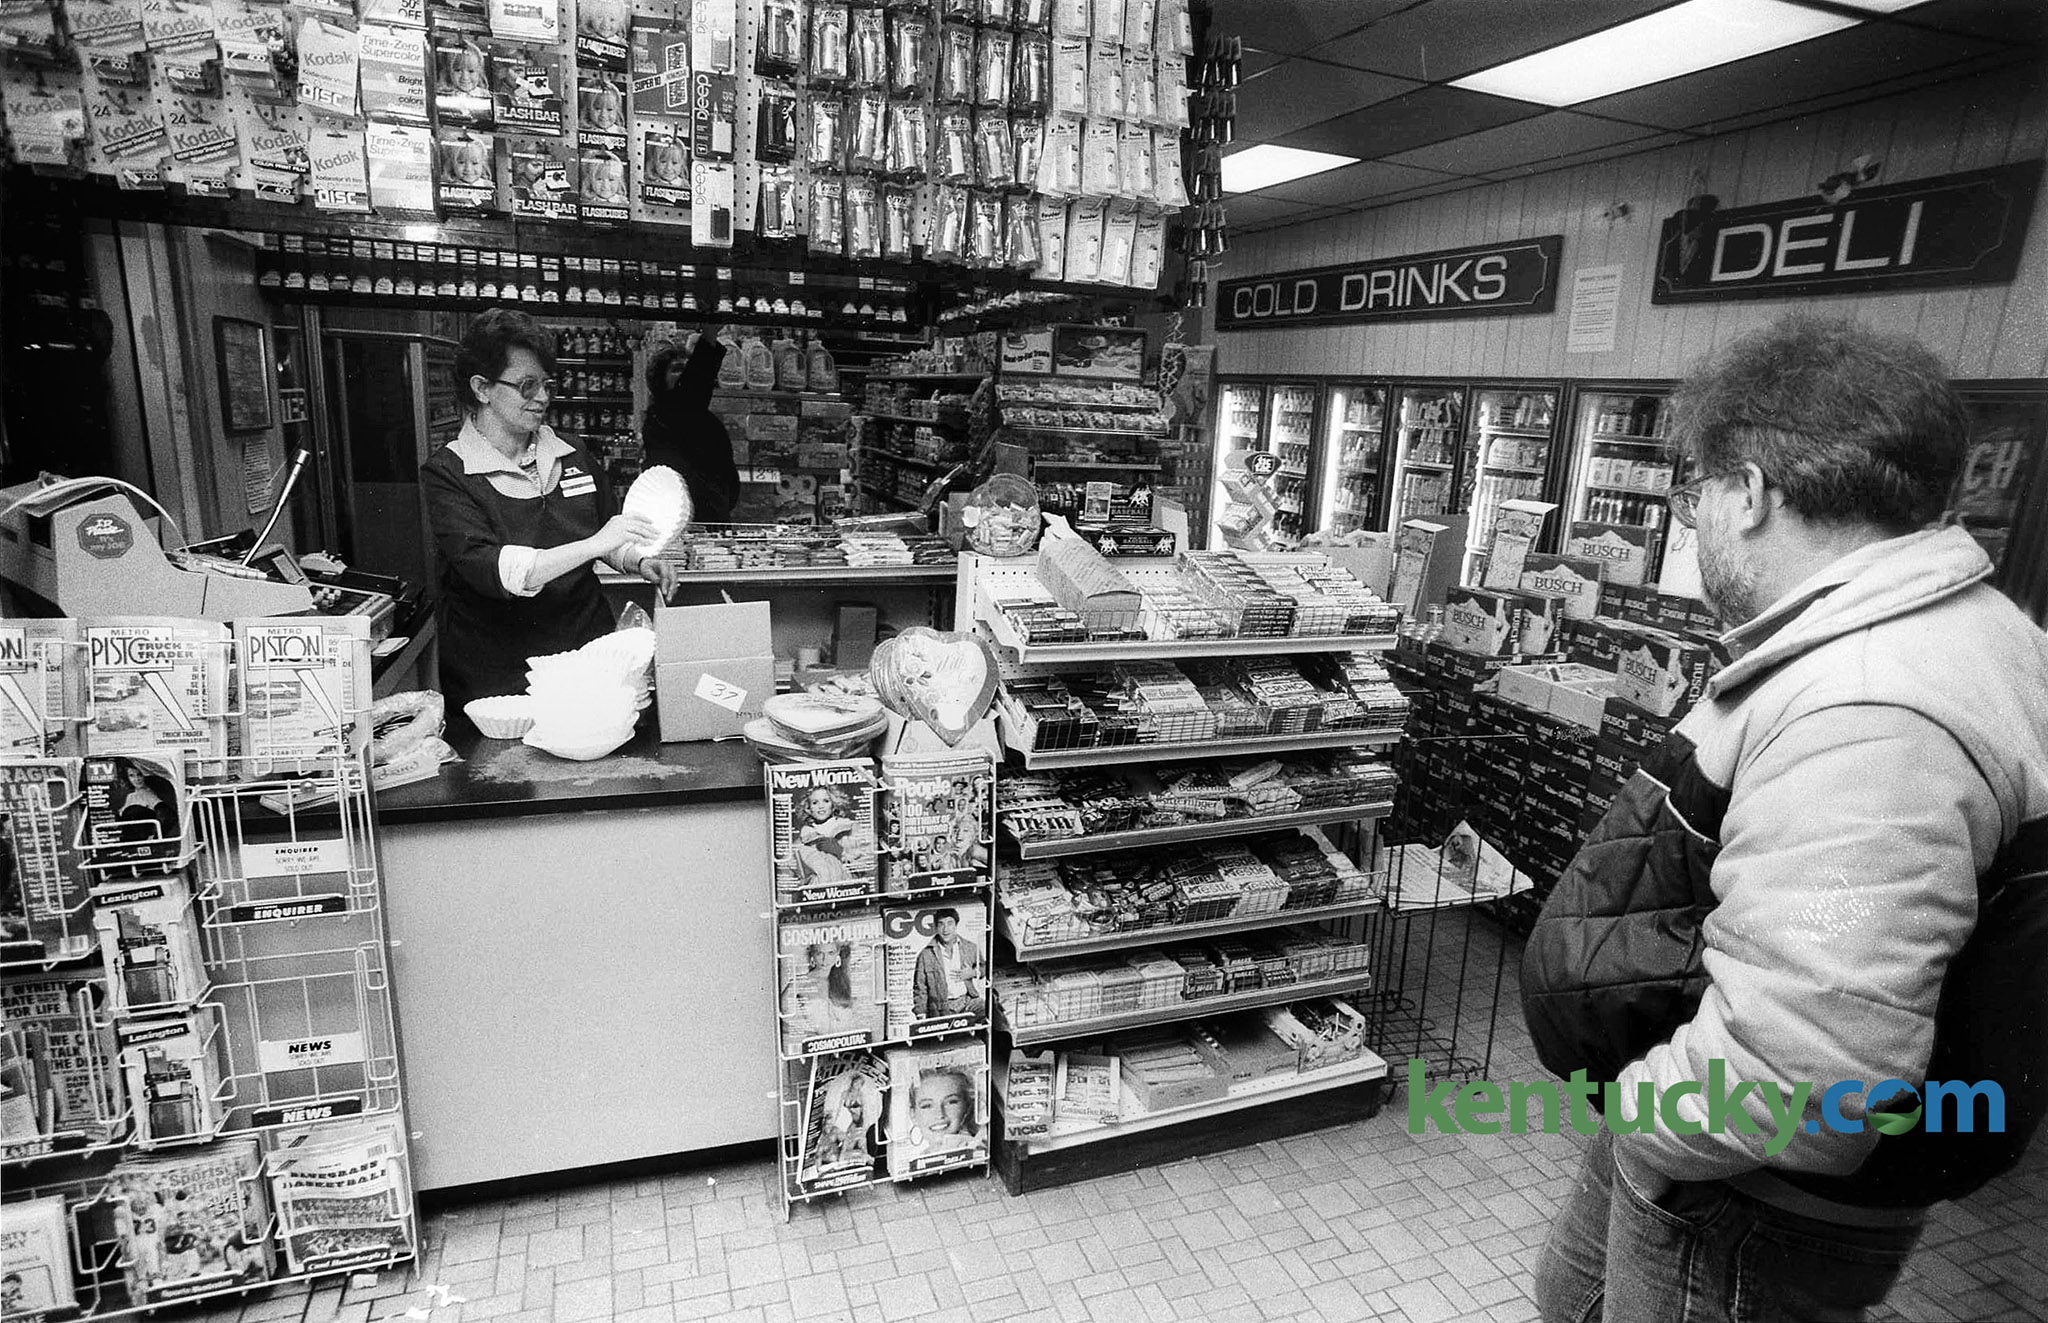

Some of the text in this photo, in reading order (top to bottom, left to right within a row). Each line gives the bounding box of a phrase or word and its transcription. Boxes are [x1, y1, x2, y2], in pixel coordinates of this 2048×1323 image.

[75, 6, 134, 29] Kodak
[218, 12, 277, 30] Kodak
[399, 8, 421, 20] OFF
[149, 14, 209, 37] Kodak
[362, 35, 419, 51] Time-Zero
[578, 37, 626, 58] FLACUBES
[304, 51, 353, 66] Kodak
[362, 45, 421, 61] Supercolor
[399, 76, 423, 86] Bright
[634, 78, 654, 91] SUPER
[407, 87, 423, 95] rich
[9, 100, 65, 118] Koda
[92, 105, 111, 117] 24
[496, 107, 560, 122] FLASH BAR
[169, 113, 187, 125] 24
[100, 115, 158, 143] Kodak
[174, 124, 232, 149] Kodak
[251, 130, 304, 151] Kodak
[314, 151, 360, 171] Kodak
[515, 199, 577, 213] FLASH BAR
[582, 206, 628, 219] FLASHCUBES
[1710, 201, 1924, 282] DELI
[1233, 255, 1508, 318] COLD DRINKS
[1582, 543, 1630, 560] BUSCH
[1535, 577, 1583, 593] BUSCH
[1453, 609, 1486, 629] BUSCH
[91, 636, 170, 666] PISTO
[137, 651, 194, 659] TRADER
[251, 636, 319, 663] PISTON
[1625, 658, 1657, 683] BUSCH
[710, 683, 738, 700] 37
[1264, 683, 1315, 695] CRUNCH
[1602, 713, 1629, 731] BUSCH
[89, 764, 113, 774] TV
[1596, 754, 1622, 773] BUSCH
[773, 771, 810, 789] New
[894, 776, 951, 800] People
[275, 847, 319, 855] ENQUIRER
[101, 889, 158, 904] Lexington
[803, 889, 826, 900] New
[253, 905, 323, 920] ENQUIRER
[5, 1004, 60, 1018] FOR LIFE
[129, 1026, 185, 1042] Lexington
[288, 1040, 332, 1054] NEWS
[282, 1106, 332, 1122] NEWS
[1008, 1124, 1048, 1137] VICKS
[290, 1160, 378, 1179] BLUEGRASS
